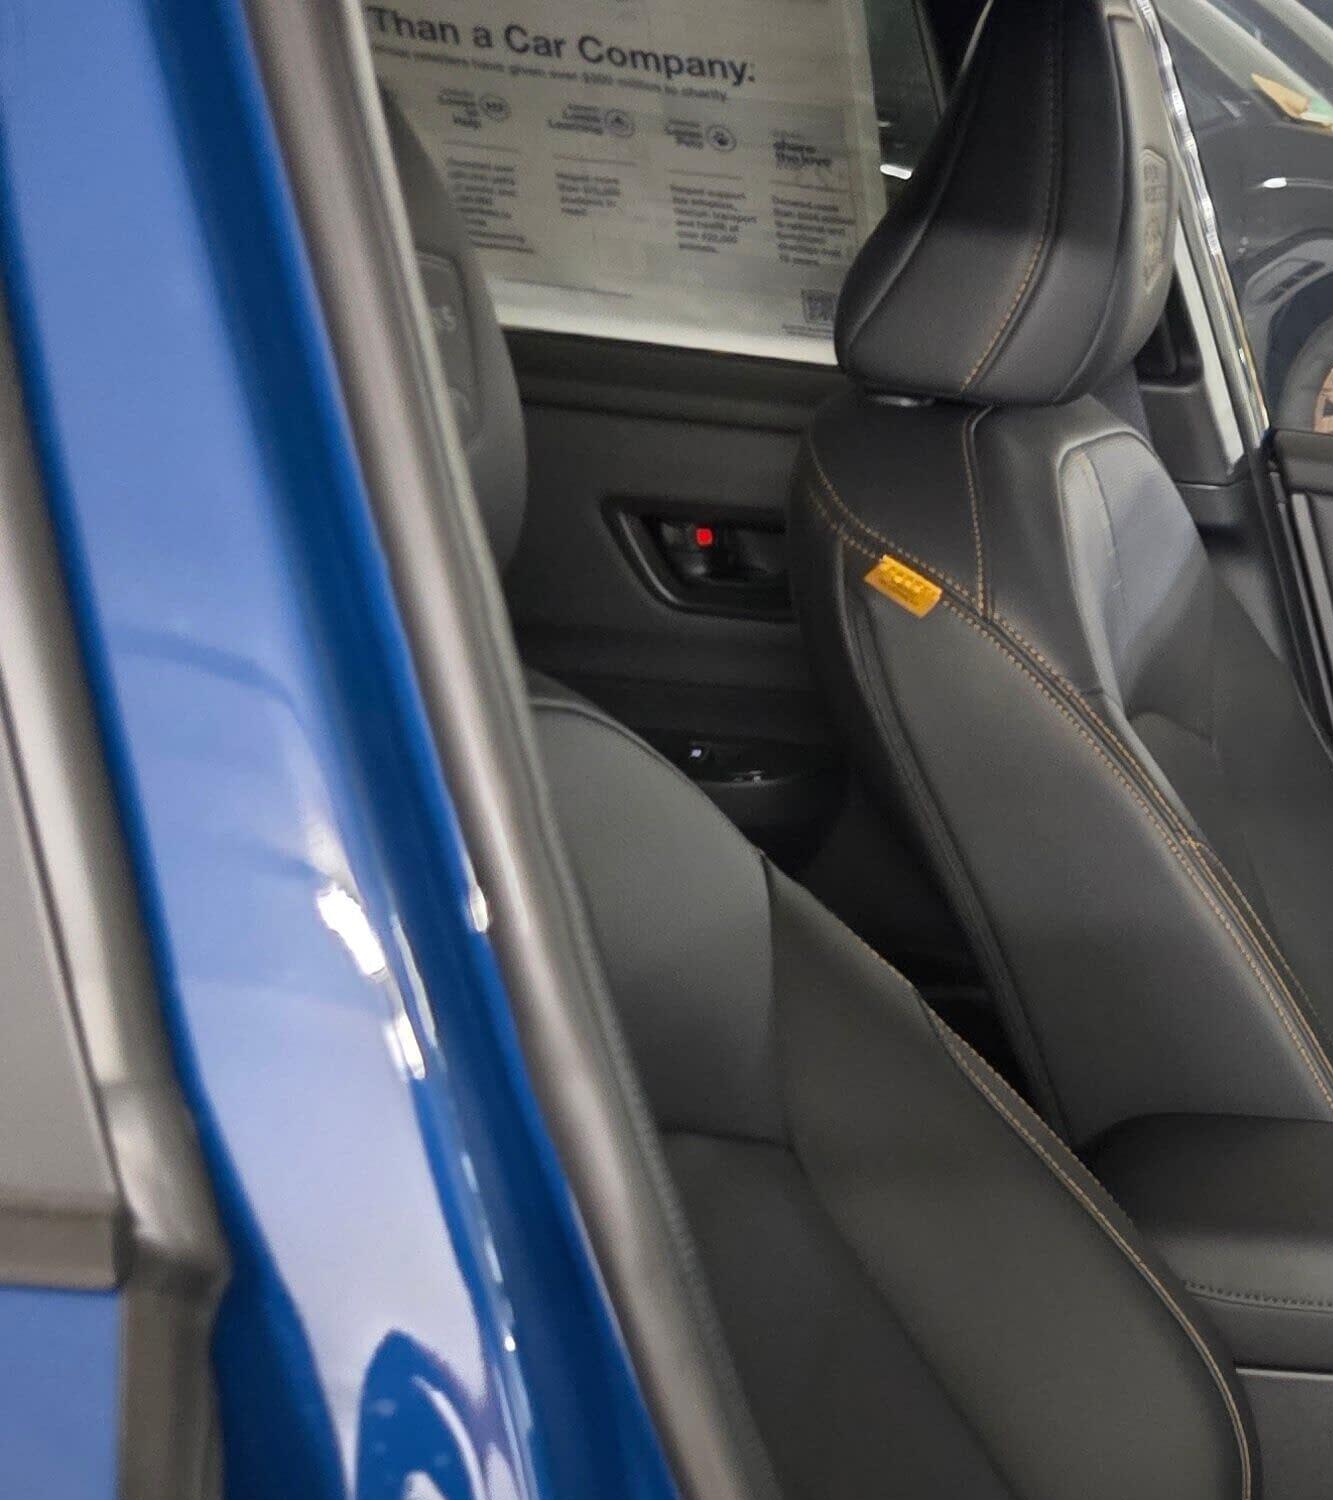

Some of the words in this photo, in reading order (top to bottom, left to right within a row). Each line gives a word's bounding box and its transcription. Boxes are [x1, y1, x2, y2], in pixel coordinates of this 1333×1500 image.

[365, 5, 461, 46] Than
[472, 24, 494, 49] a
[504, 23, 566, 58] Car
[577, 34, 756, 87] Company.
